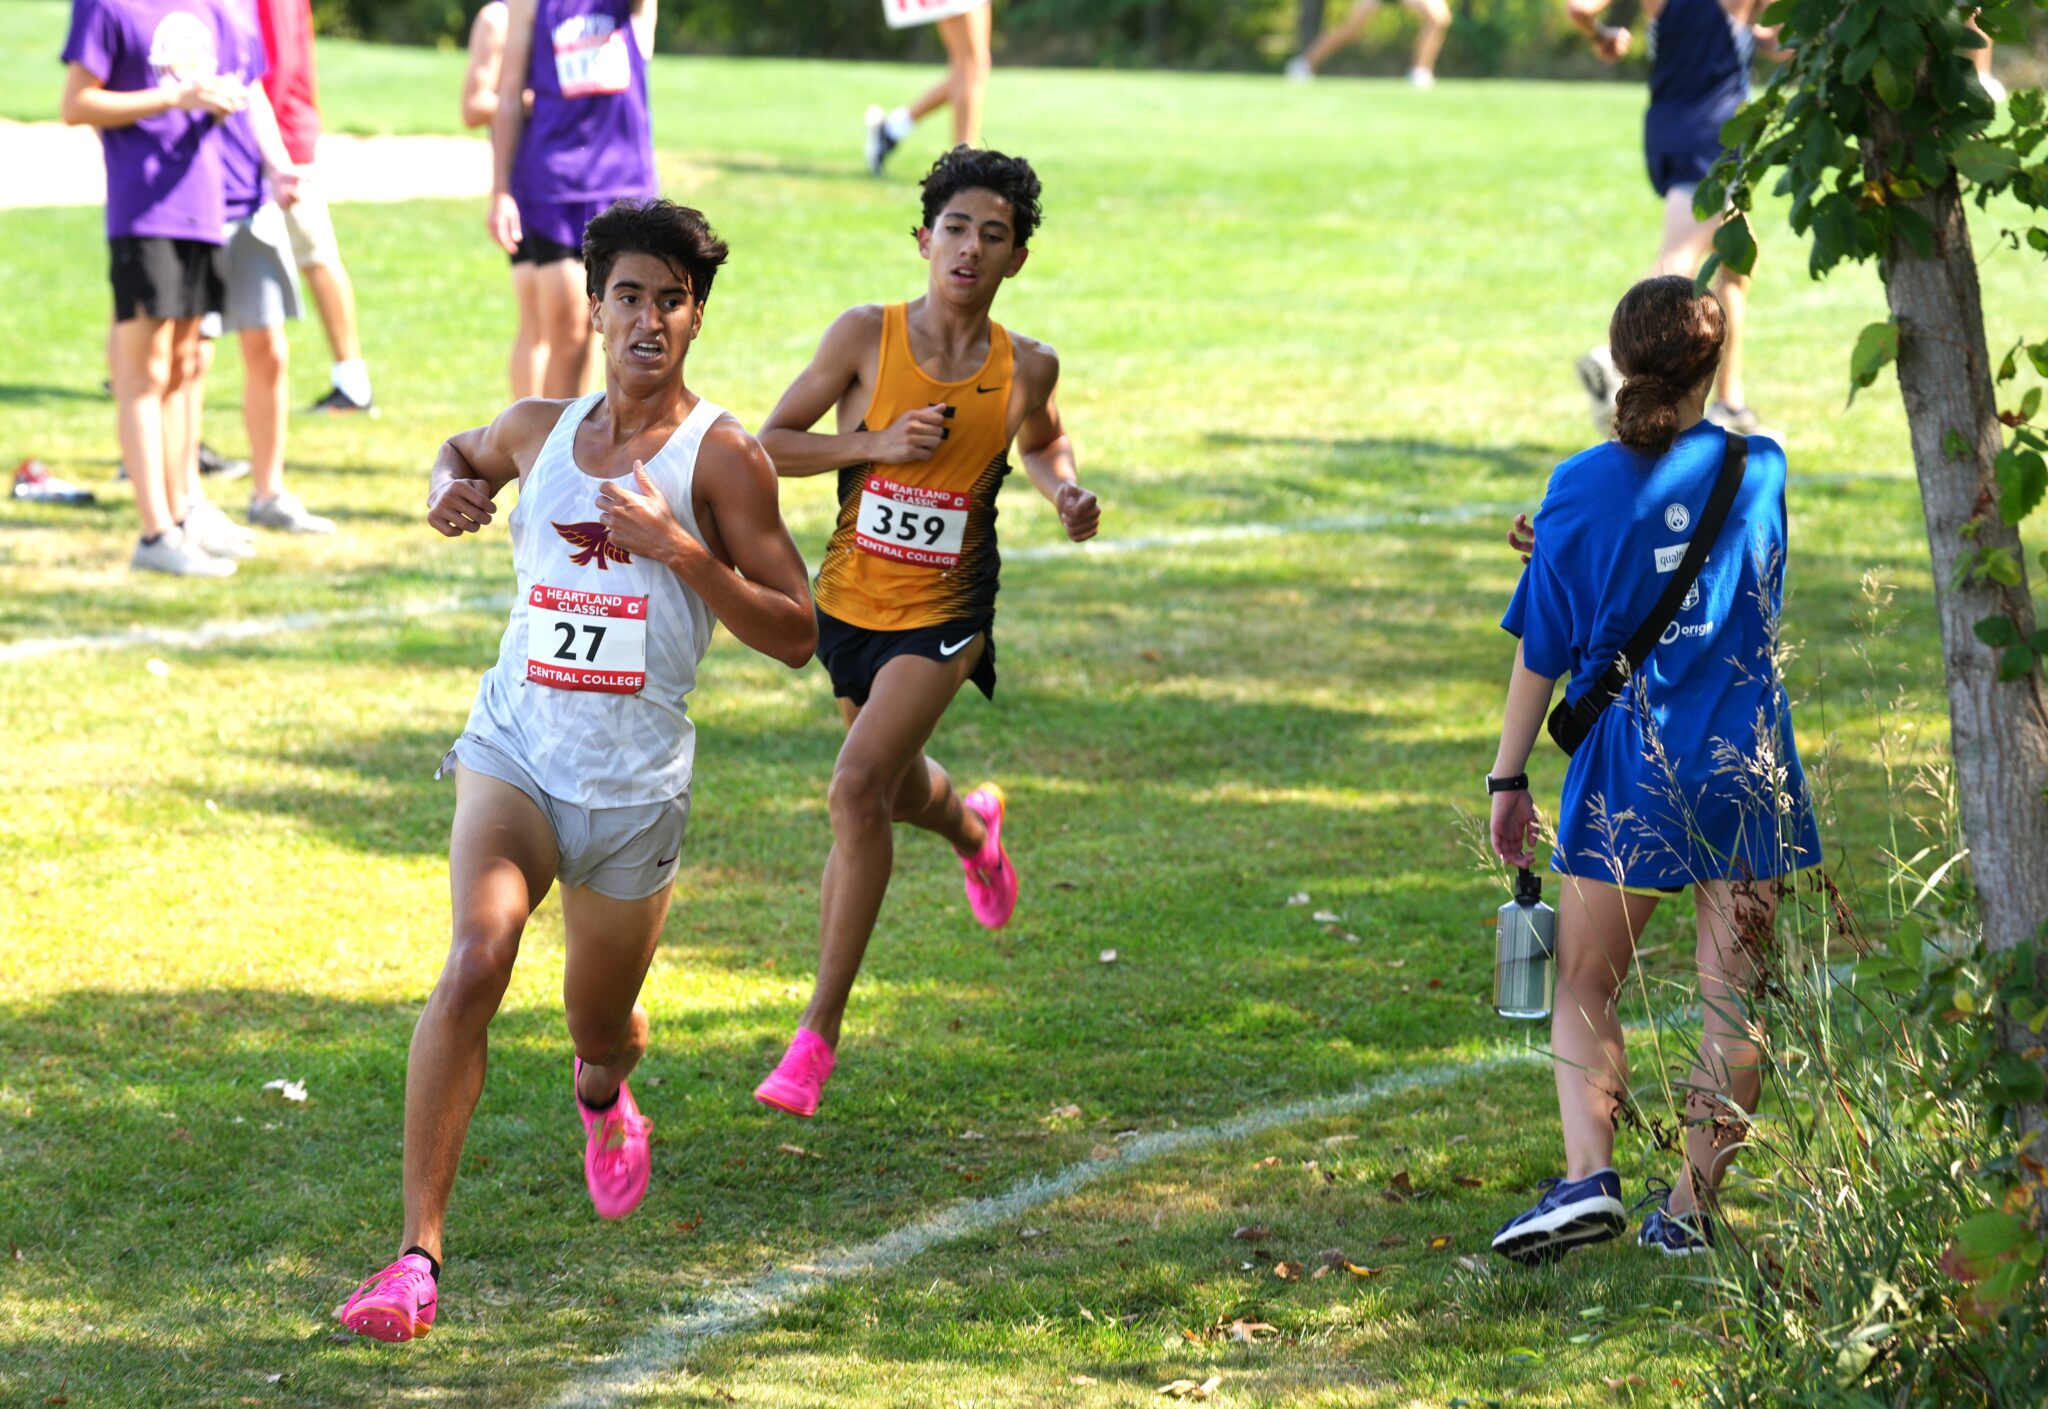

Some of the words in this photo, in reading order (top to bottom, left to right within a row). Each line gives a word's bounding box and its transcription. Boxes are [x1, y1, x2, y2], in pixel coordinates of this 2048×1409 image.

[884, 481, 951, 501] HEARTLAND
[893, 493, 939, 508] CLASSIC
[872, 504, 945, 546] 359
[856, 536, 904, 558] CENTRAL
[906, 552, 958, 566] COLLEGE
[546, 588, 622, 607] HEARTLAND
[557, 601, 609, 616] CLASSIC
[553, 621, 607, 663] 27
[529, 664, 579, 684] CENTRAL
[582, 674, 642, 687] COLLEGE
